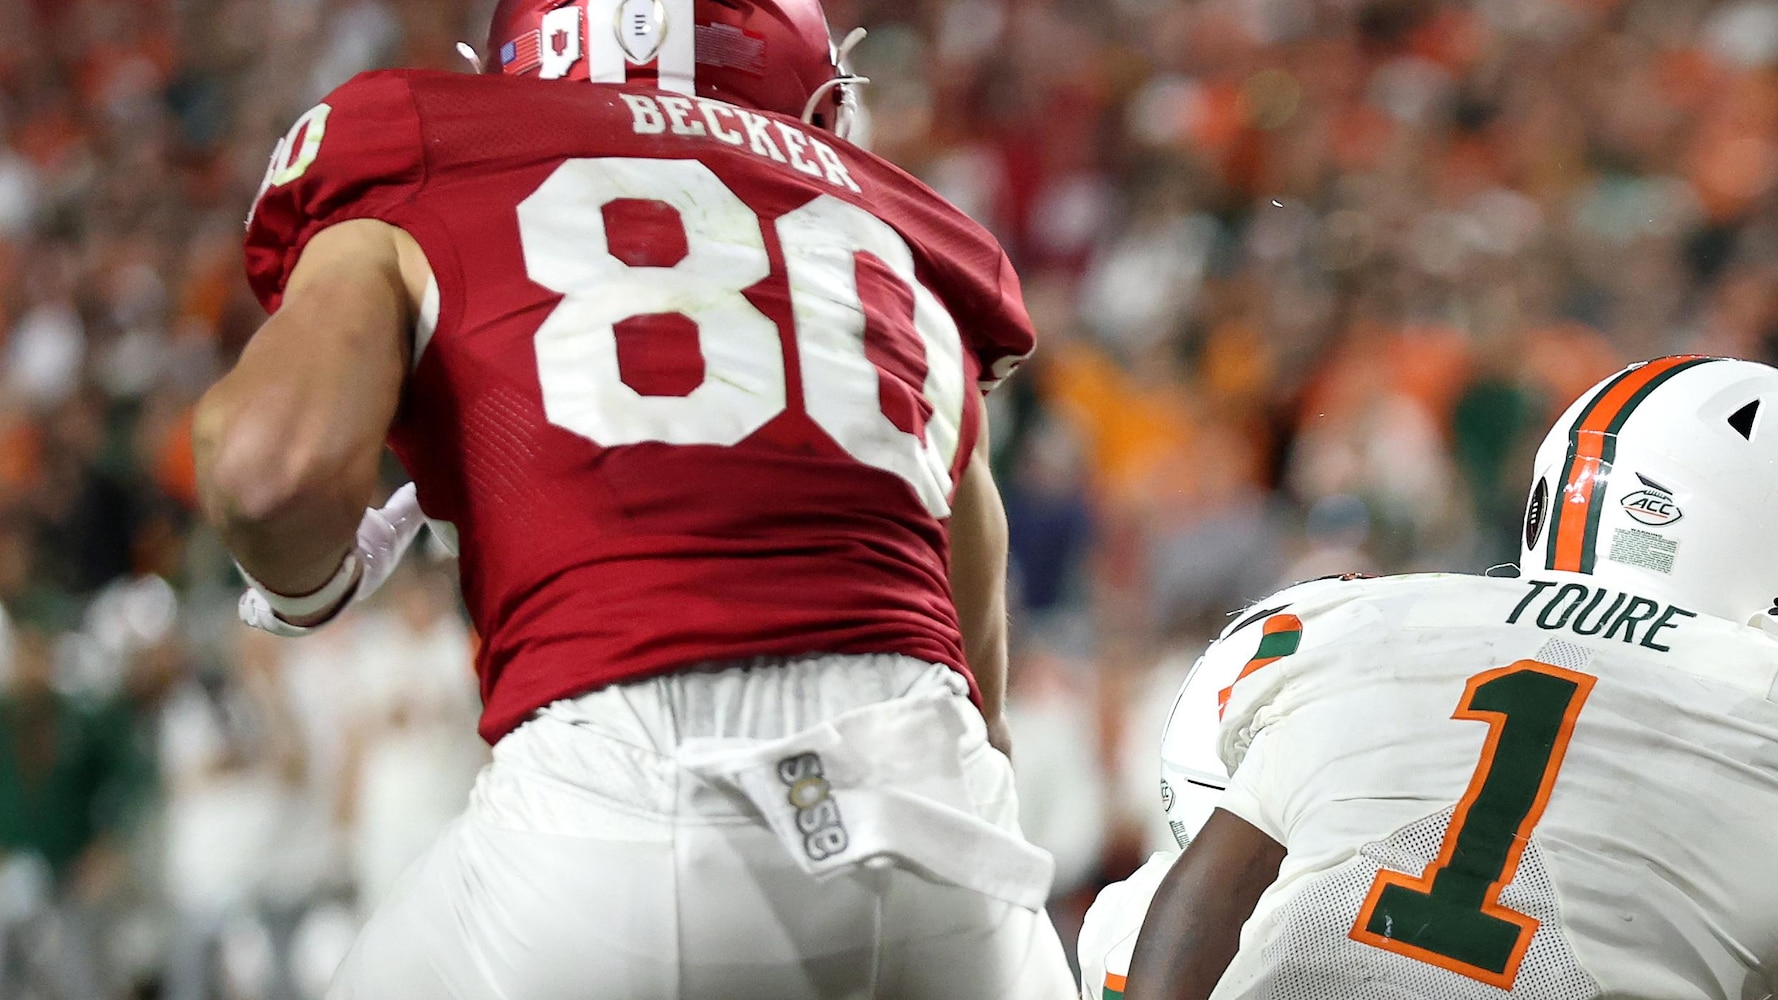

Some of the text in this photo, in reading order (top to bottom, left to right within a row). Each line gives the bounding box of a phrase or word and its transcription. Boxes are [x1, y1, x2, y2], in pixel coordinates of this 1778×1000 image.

[618, 92, 863, 193] BECKER
[516, 156, 965, 520] 80
[1628, 497, 1675, 516] ACC
[1505, 579, 1699, 654] TOURE
[1348, 659, 1598, 992] 1
